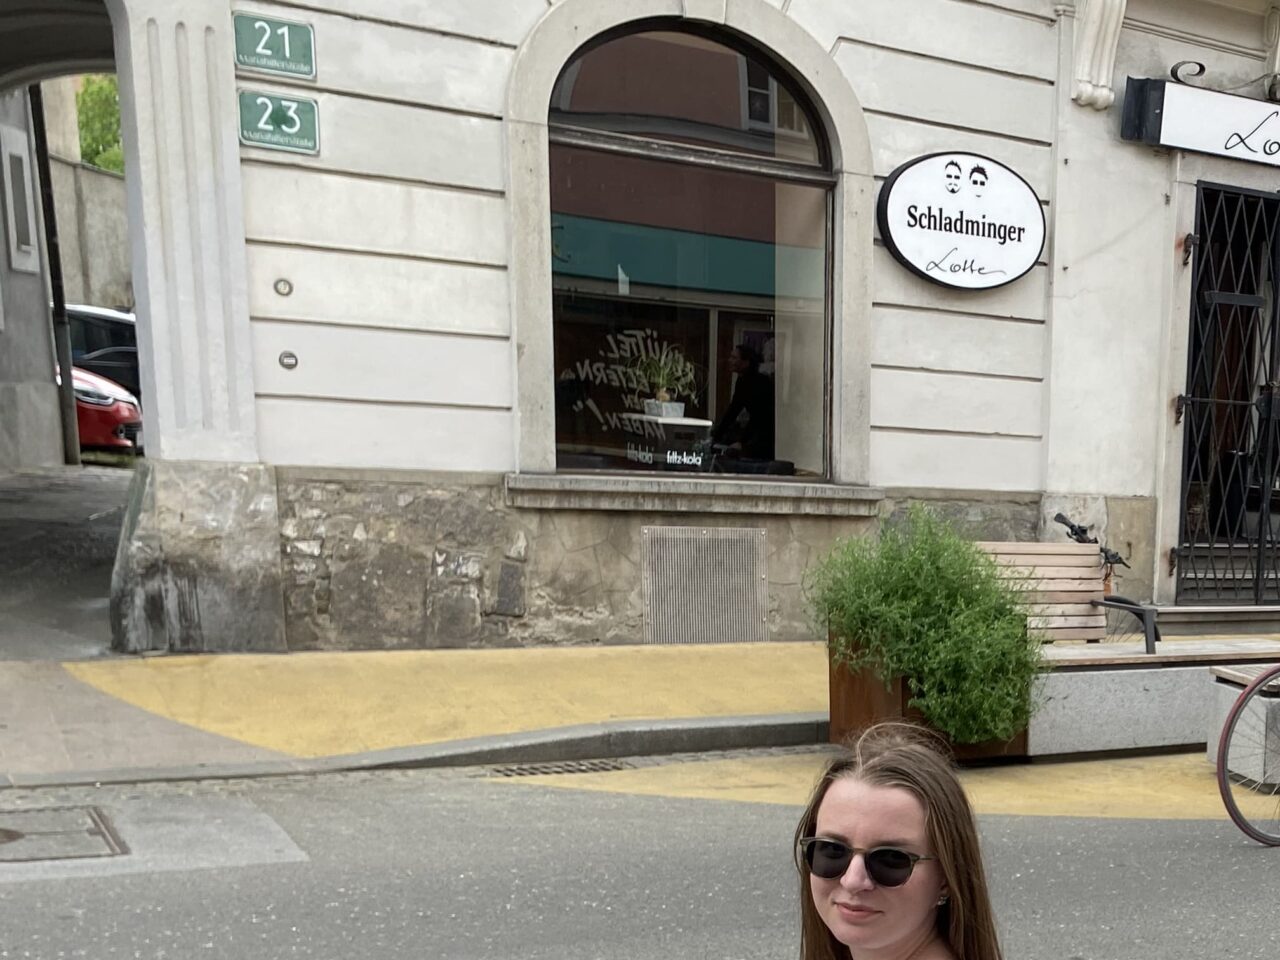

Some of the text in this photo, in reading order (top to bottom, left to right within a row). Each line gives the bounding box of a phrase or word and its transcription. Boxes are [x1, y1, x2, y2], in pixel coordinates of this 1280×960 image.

[254, 20, 291, 59] 21
[255, 96, 301, 134] 23
[906, 204, 1026, 246] Schladminger
[925, 247, 1007, 276] Lotte
